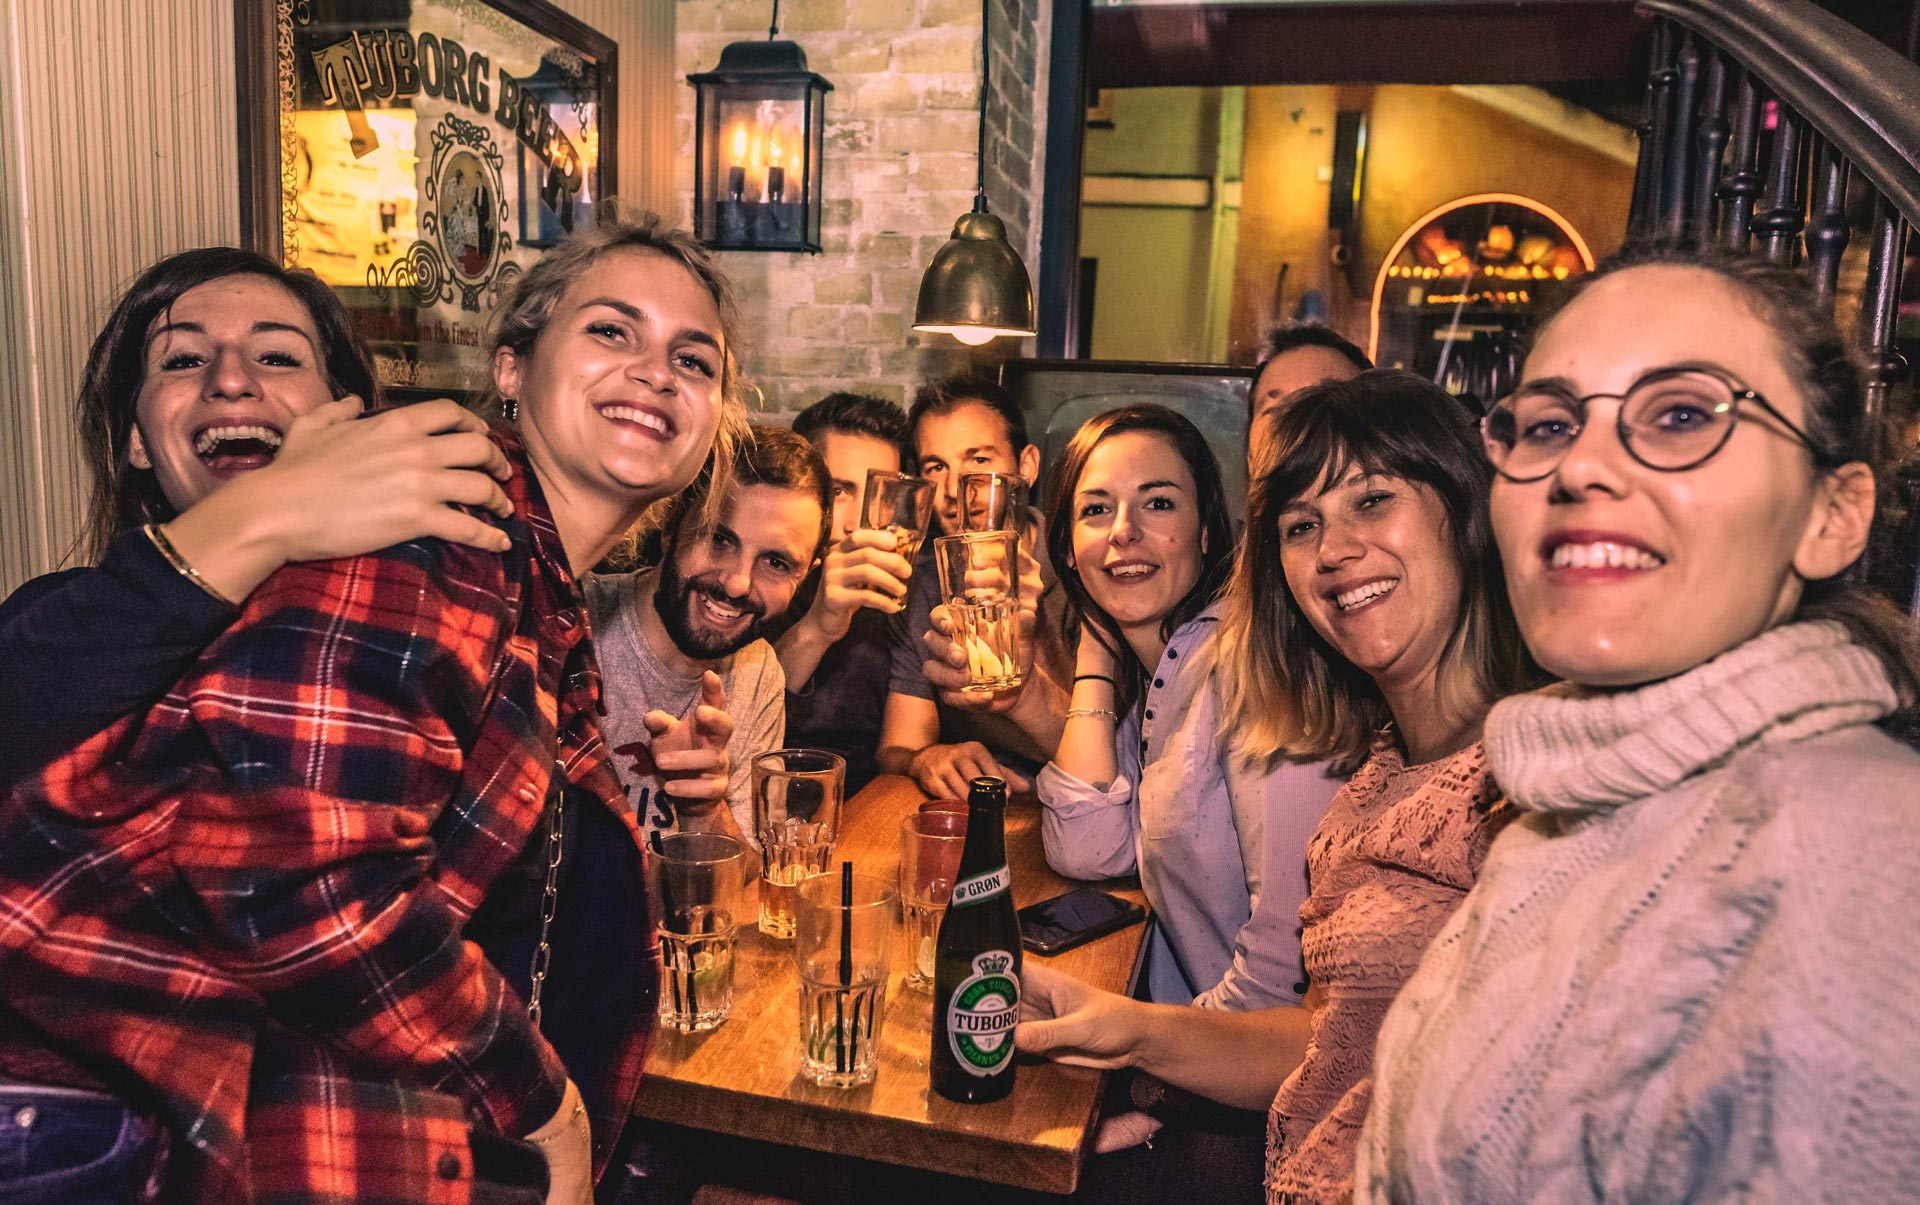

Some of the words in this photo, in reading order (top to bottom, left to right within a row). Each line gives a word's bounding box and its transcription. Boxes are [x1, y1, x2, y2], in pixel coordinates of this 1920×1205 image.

[311, 30, 491, 159] TUBORG
[495, 67, 583, 234] BEER
[434, 318, 450, 345] the
[967, 874, 1001, 897] GRØN
[954, 1008, 1018, 1031] TUBORG
